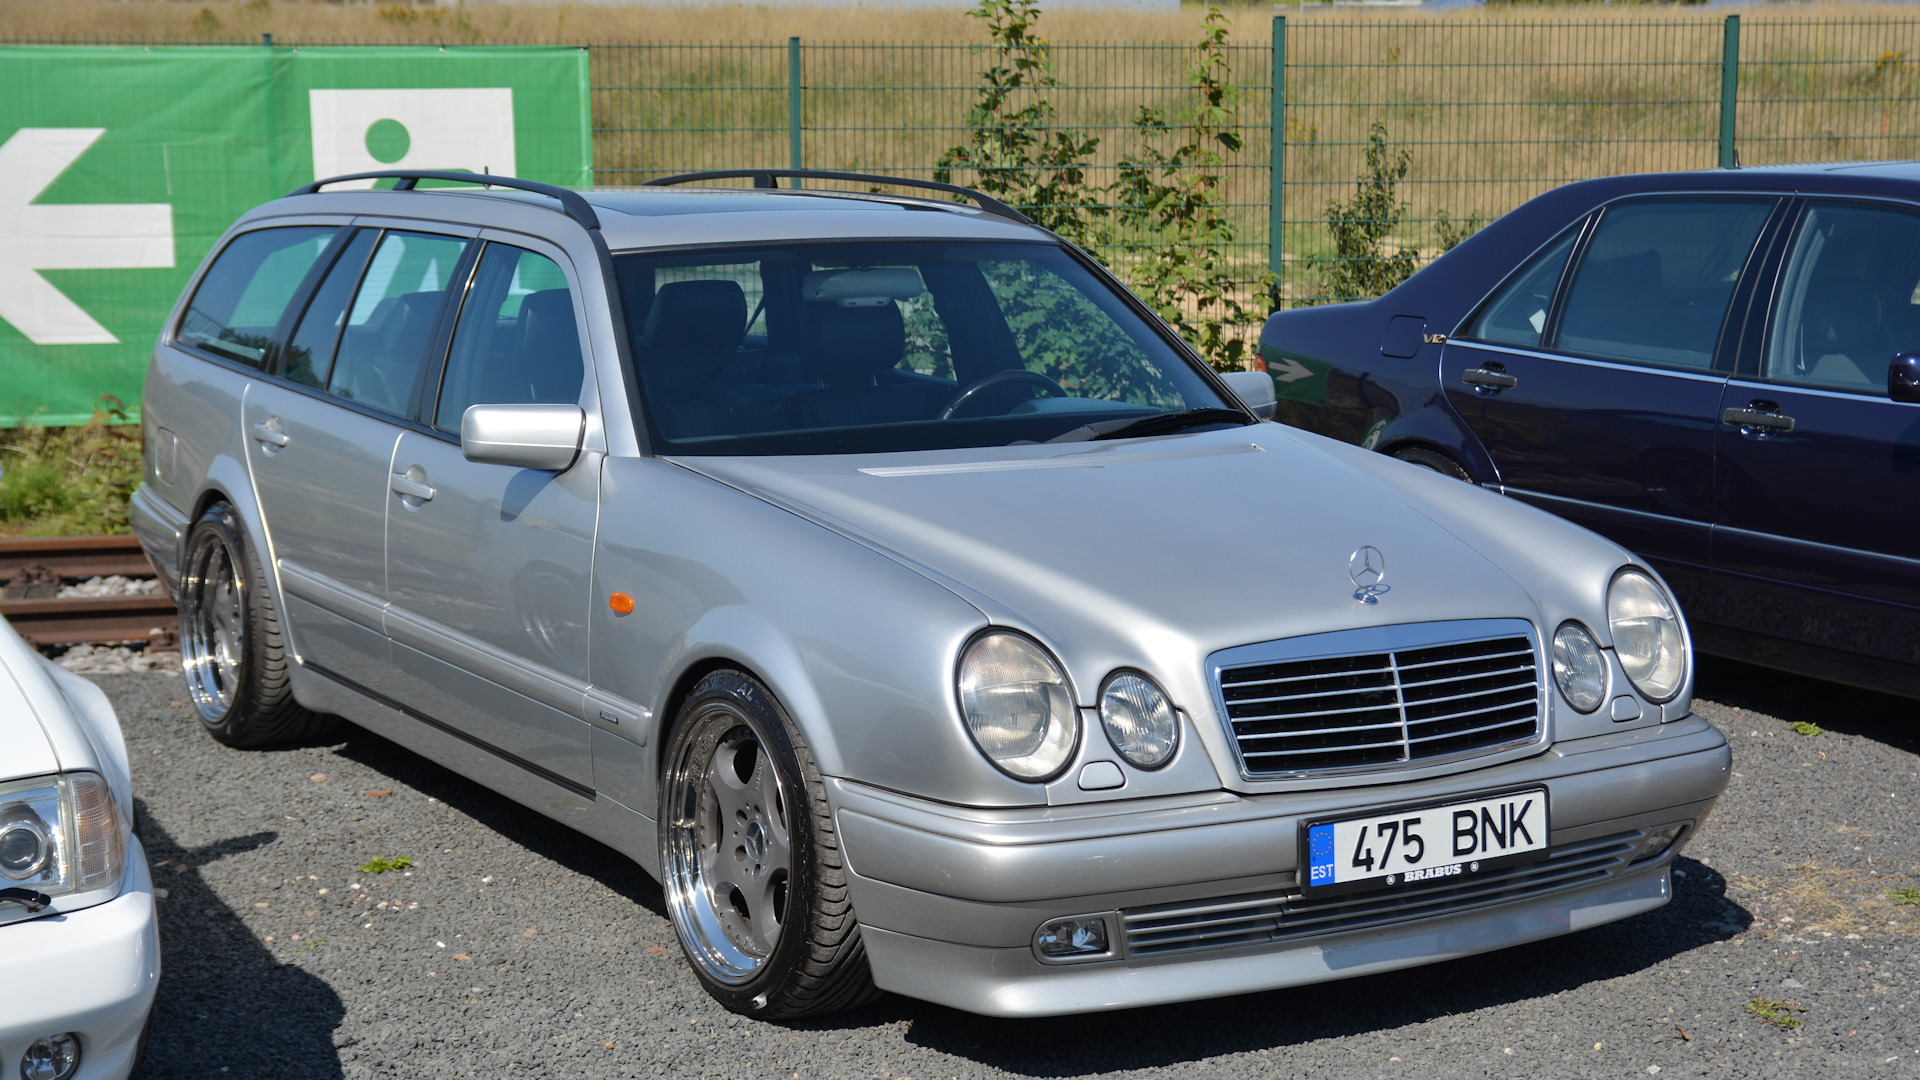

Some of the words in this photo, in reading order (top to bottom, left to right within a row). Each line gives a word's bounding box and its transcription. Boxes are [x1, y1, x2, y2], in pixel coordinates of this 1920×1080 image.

[1424, 333, 1446, 344] V12
[698, 677, 754, 702] UNIROYAL
[1352, 817, 1424, 872] 475
[1453, 799, 1534, 857] BNK
[1311, 864, 1334, 880] EST
[1404, 864, 1462, 882] BRABUS
